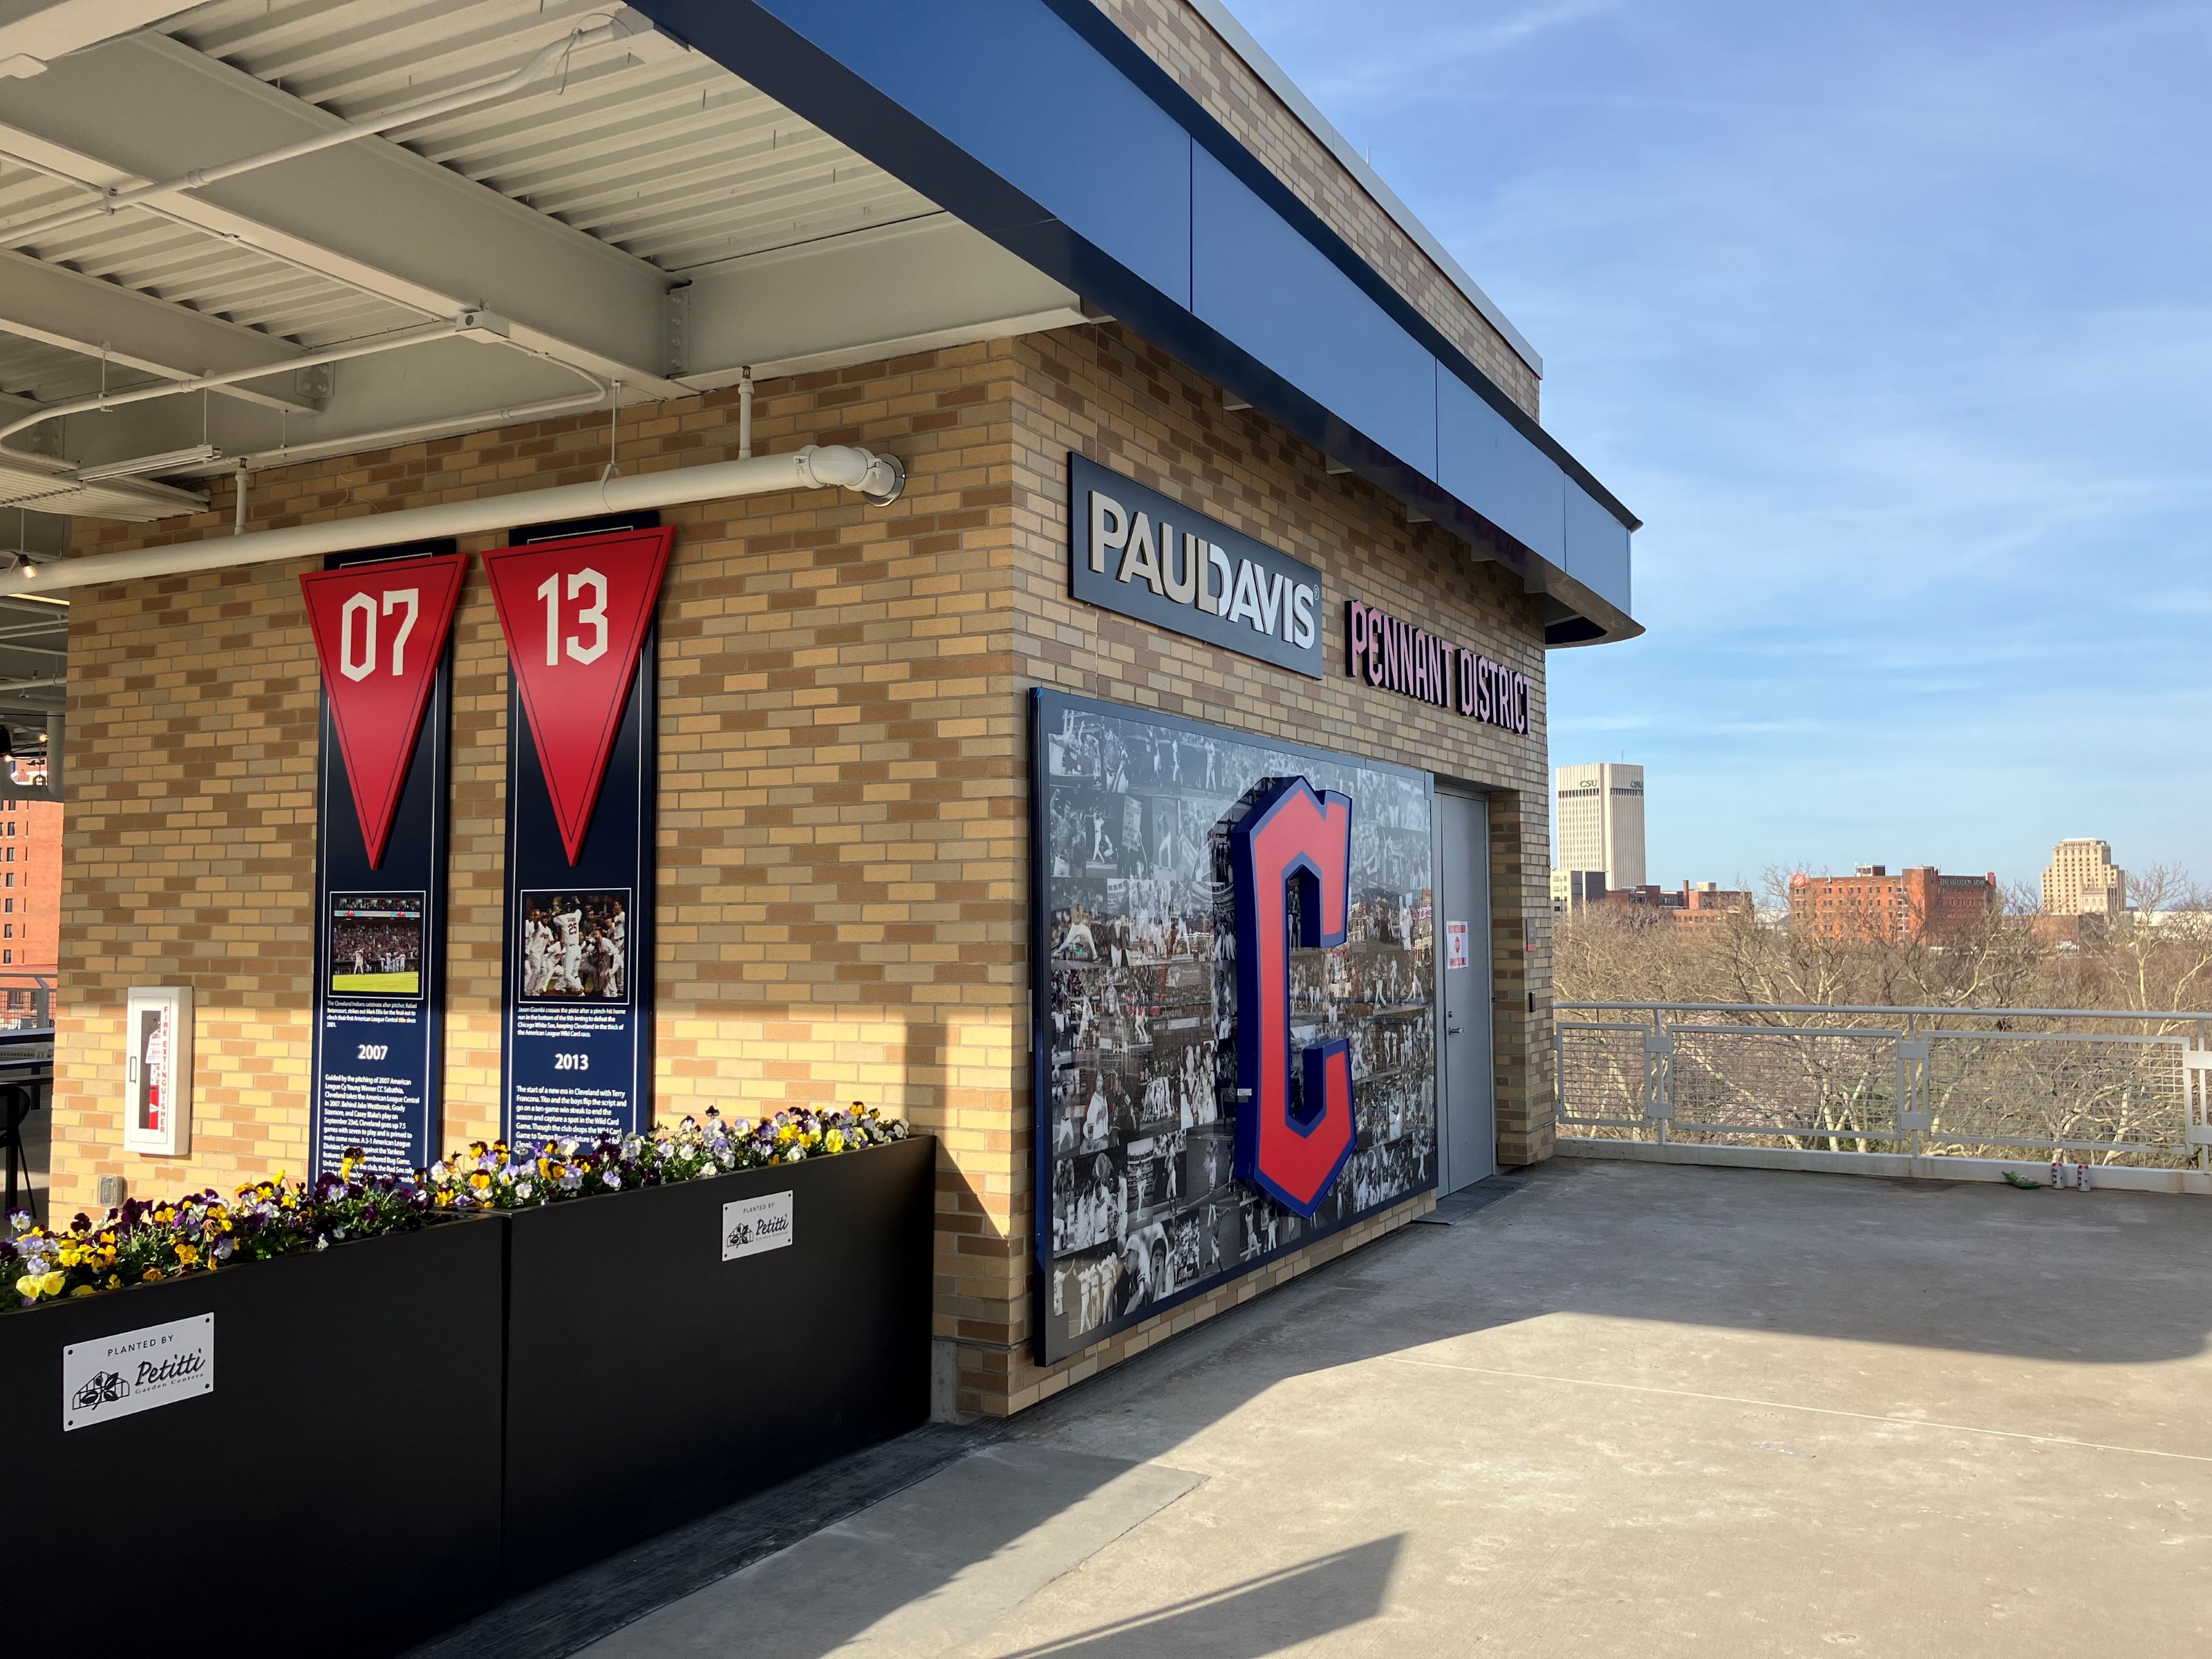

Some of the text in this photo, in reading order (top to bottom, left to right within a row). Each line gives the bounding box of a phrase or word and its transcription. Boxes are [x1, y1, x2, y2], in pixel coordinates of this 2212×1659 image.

[538, 567, 608, 666] 13
[340, 588, 419, 682] 07
[1346, 600, 1533, 734] PENNANT DISTRICT
[568, 923, 577, 935] 25
[359, 1044, 388, 1060] 2007
[554, 1053, 589, 1070] 2013
[570, 1097, 583, 1106] boys
[583, 1098, 591, 1107] flip
[601, 1099, 616, 1107] script
[612, 1090, 626, 1099] Terry
[743, 1204, 767, 1214] PLANTED
[756, 1214, 789, 1235] Petitti
[108, 1334, 174, 1356] PLANTED BY
[135, 1348, 205, 1387] Petitti
[135, 1373, 204, 1394] Garden Centers
